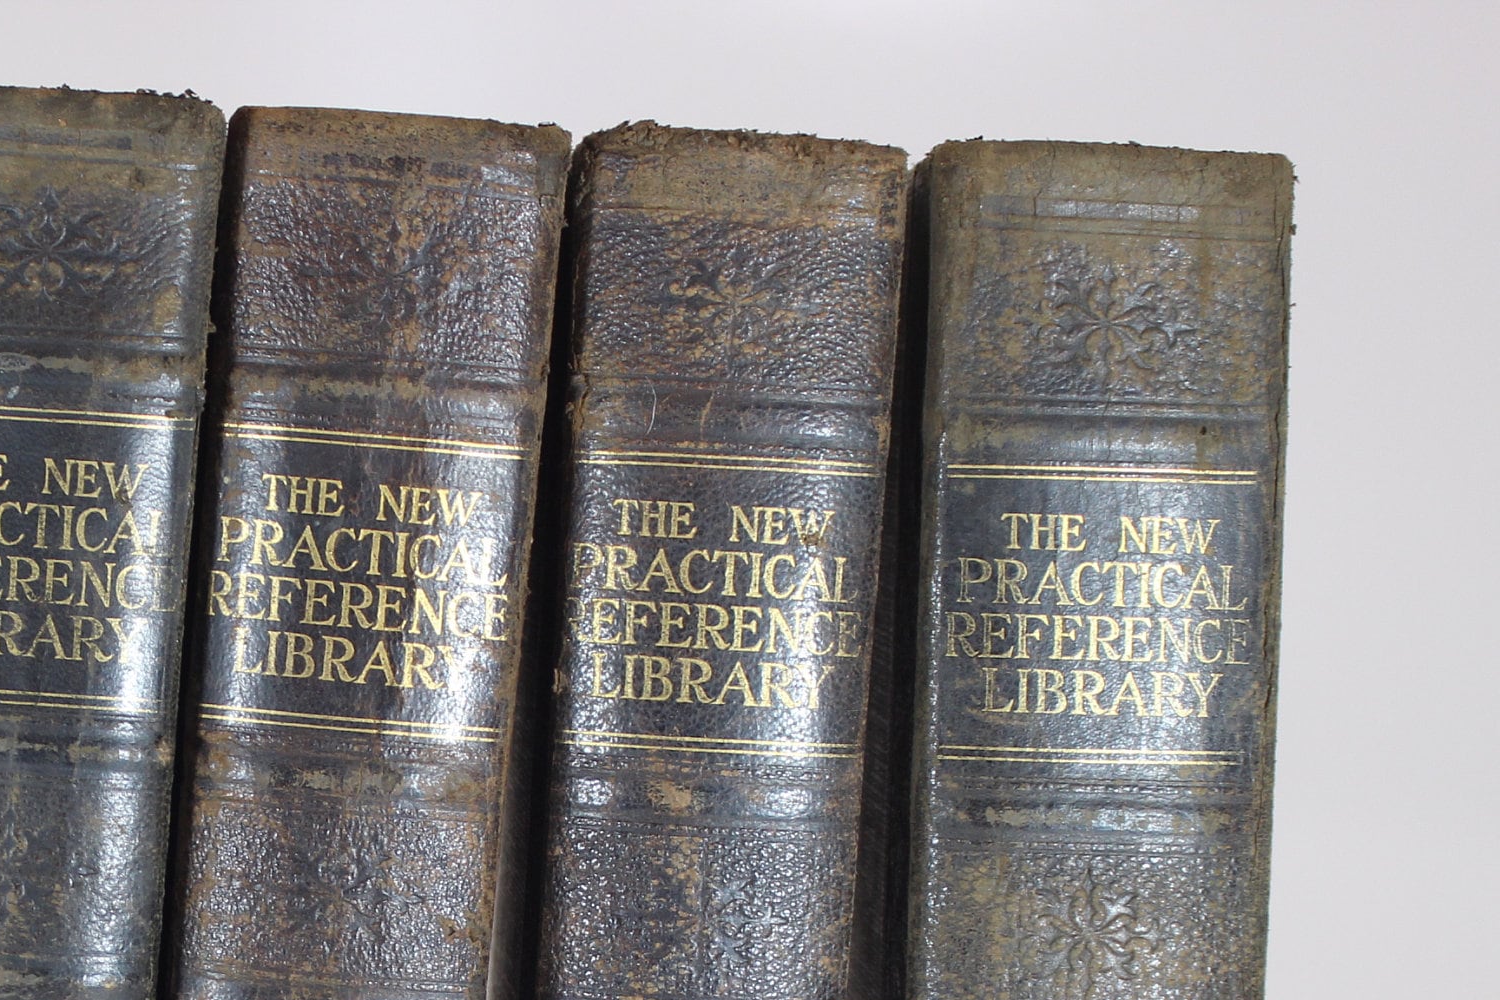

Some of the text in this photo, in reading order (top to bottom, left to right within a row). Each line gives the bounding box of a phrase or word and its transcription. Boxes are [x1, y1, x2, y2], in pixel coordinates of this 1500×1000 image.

[41, 457, 151, 501] NEW
[262, 473, 484, 528] THE NEW
[614, 498, 835, 546] THE NEW
[1001, 513, 1221, 555] THE NEW
[216, 516, 509, 588] PRACTICAL
[570, 542, 857, 604] PRACTICAL
[209, 570, 509, 641] REFERENCE
[956, 557, 1248, 611] PRACTICAL
[566, 597, 861, 658] REFERENCE
[945, 611, 1250, 665] REFERENCE
[591, 652, 835, 709] LIBRARY
[982, 667, 1223, 718] LIBRARY
